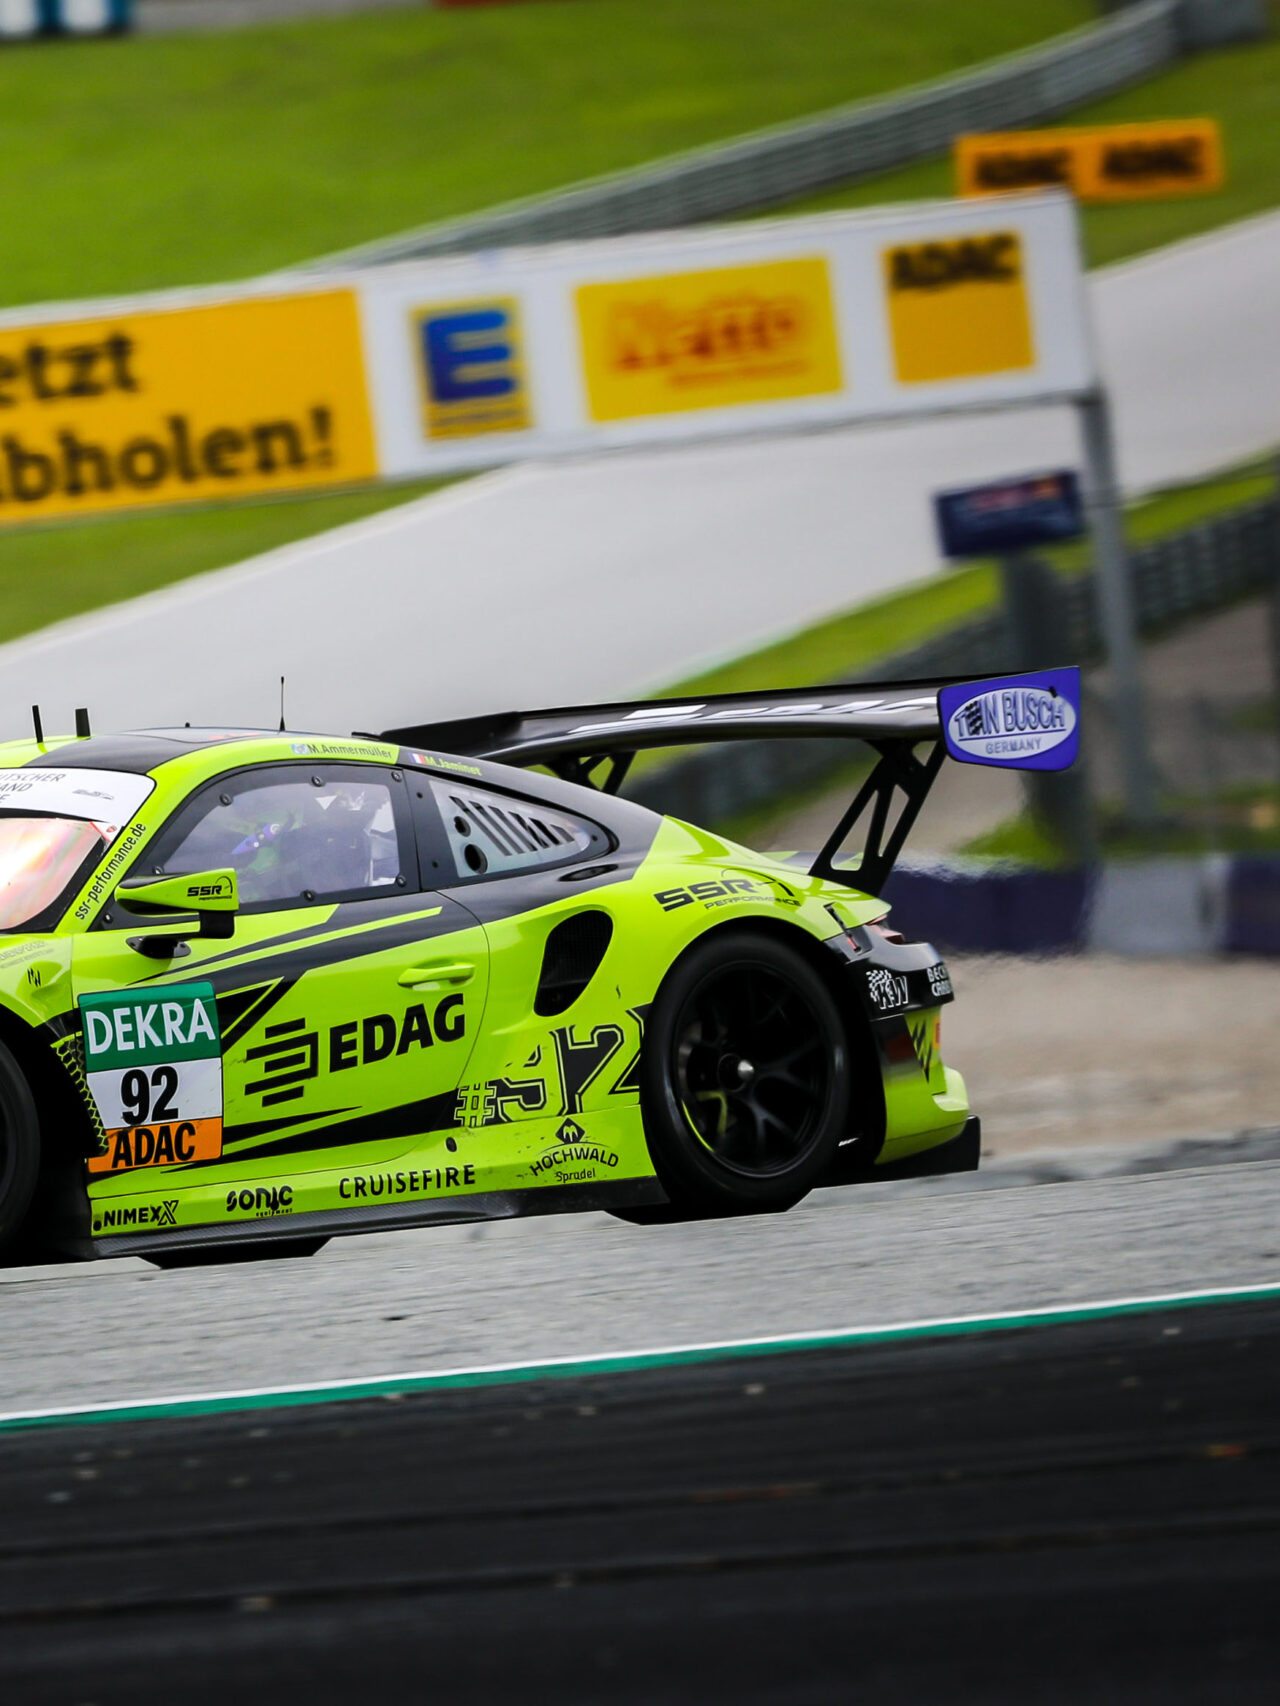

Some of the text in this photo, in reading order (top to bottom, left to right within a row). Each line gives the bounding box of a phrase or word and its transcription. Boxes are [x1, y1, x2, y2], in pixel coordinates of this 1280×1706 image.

[890, 231, 1019, 293] ADAC
[423, 310, 515, 402] E
[1001, 691, 1065, 732] BUSCH
[985, 738, 1042, 755] GERMANY
[75, 823, 147, 920] ssr-performance.de
[187, 885, 222, 897] SSR
[653, 879, 759, 912] SSR
[85, 998, 217, 1054] DEKRA
[329, 993, 466, 1073] EDAG
[120, 1066, 179, 1125] 92
[111, 1122, 196, 1168] ADAC
[529, 1146, 620, 1177] HOCHWALD
[339, 1164, 476, 1200] CRUISEFIRE
[555, 1167, 597, 1184] Sprudel
